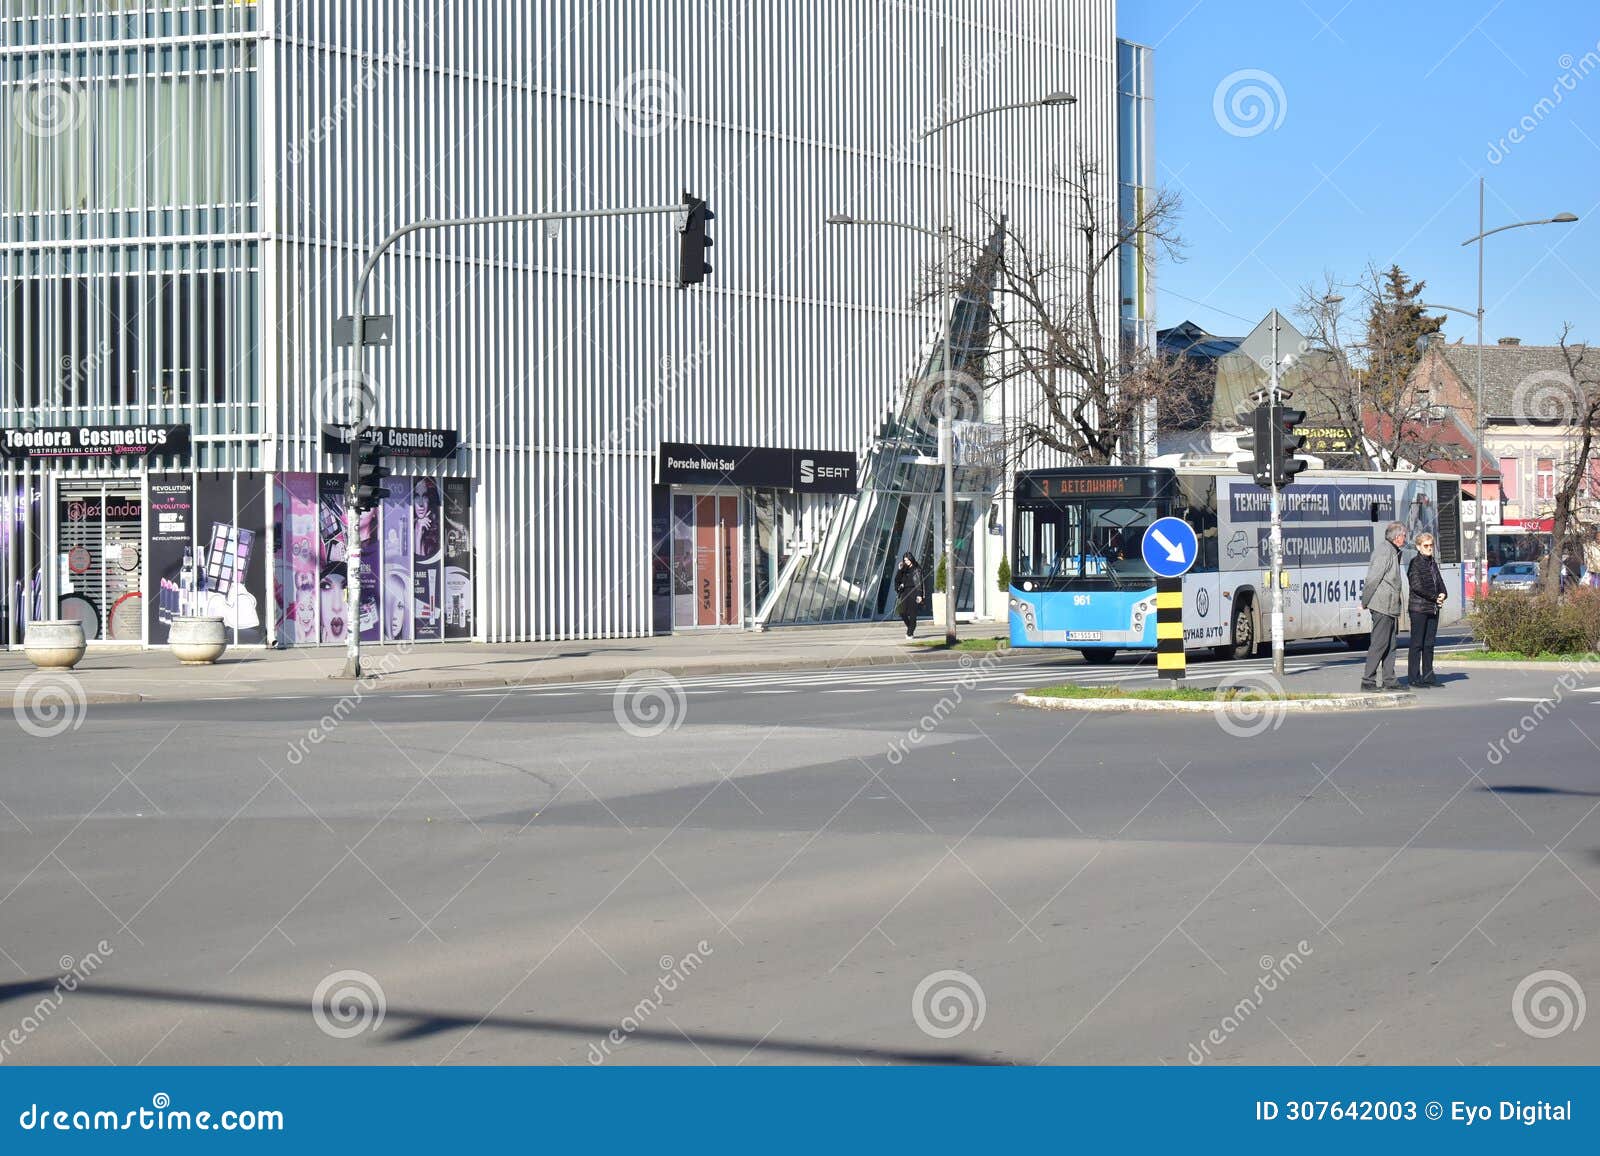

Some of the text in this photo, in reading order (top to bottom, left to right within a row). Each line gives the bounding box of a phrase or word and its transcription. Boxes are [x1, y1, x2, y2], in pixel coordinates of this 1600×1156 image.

[5, 427, 167, 447] Teodora Cosmetics
[389, 429, 444, 449] Cosmetics
[668, 457, 735, 471] Porsche Novi Sad
[817, 466, 850, 478] SEAT
[1287, 493, 1330, 516] ПРЕГЛЕД
[1334, 535, 1371, 555] ВОЗИЛА
[1074, 594, 1091, 606] 961
[1303, 580, 1341, 604] 021/66
[1344, 580, 1357, 601] 14
[1205, 625, 1223, 639] АУТО
